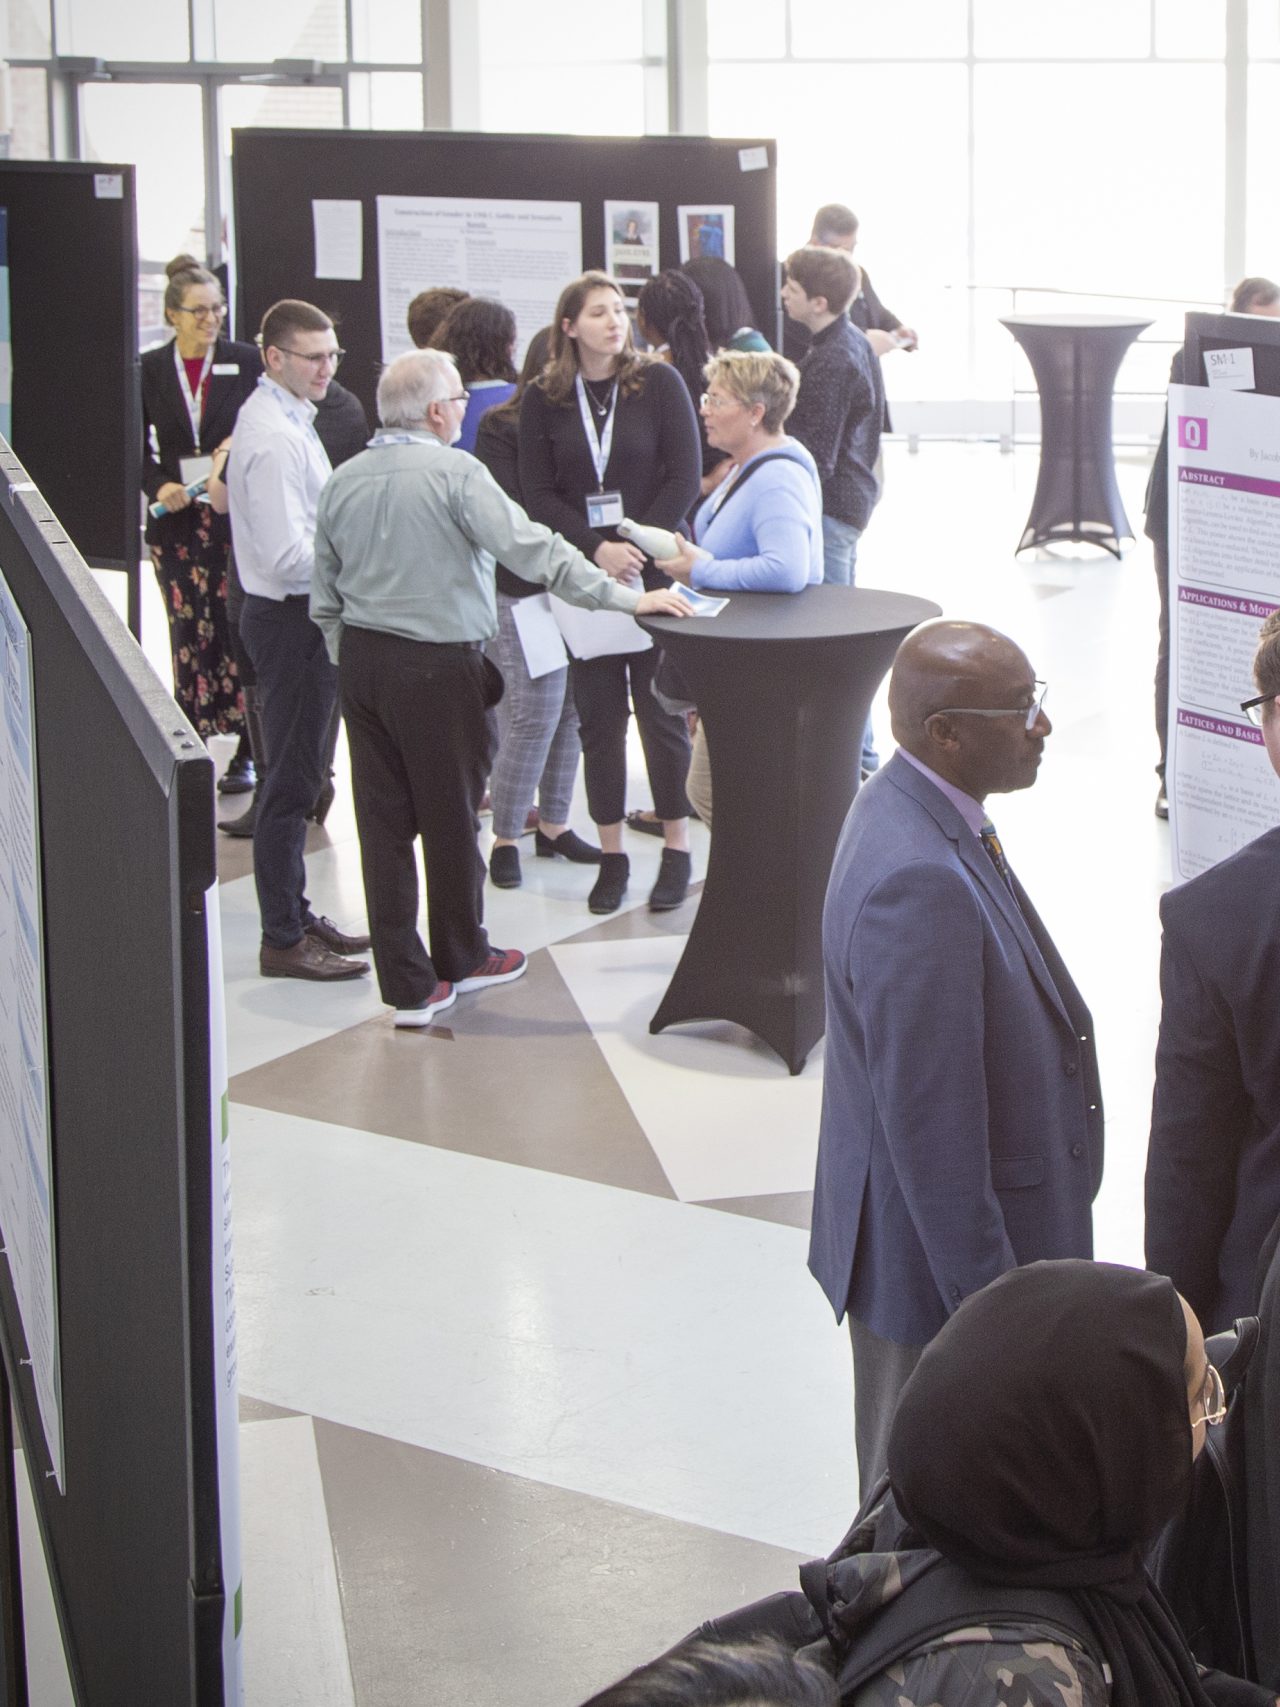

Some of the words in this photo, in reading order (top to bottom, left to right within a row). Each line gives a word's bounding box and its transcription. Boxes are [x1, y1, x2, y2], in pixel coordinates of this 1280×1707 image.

[1261, 449, 1280, 463] Jacob
[1181, 469, 1225, 486] ABSTRACT
[1180, 589, 1237, 610] APPLICATIONS
[1239, 601, 1248, 612] &
[1178, 712, 1215, 731] LATTICES
[1216, 723, 1233, 736] AND
[1235, 727, 1262, 743] BASES
